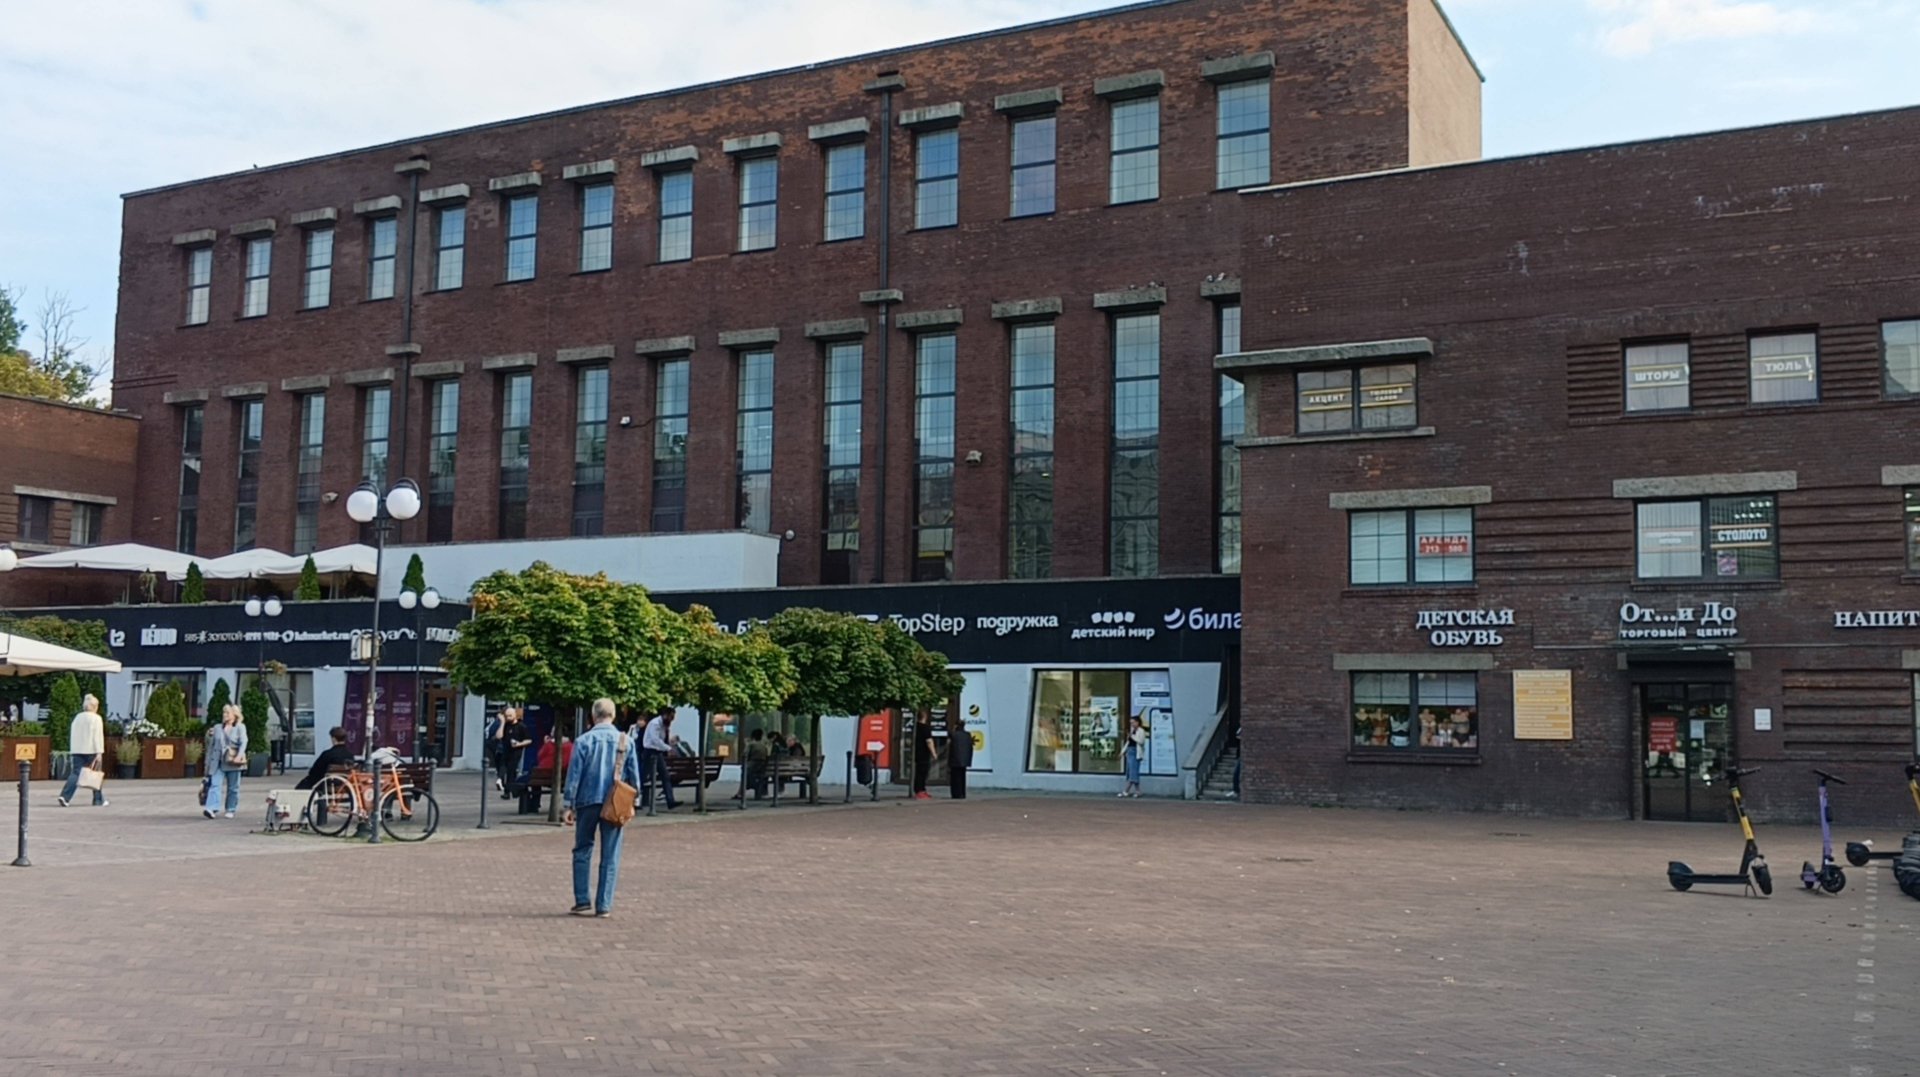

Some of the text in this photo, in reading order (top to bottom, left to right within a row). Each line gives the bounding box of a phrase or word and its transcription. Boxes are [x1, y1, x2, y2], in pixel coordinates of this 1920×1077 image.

[1765, 362, 1801, 372] ТЮЛЬ
[1634, 370, 1680, 382] ШТОРЫ
[1309, 393, 1344, 404] АКЦЕНТ
[1421, 536, 1467, 544] АРЕНДА
[1717, 528, 1767, 542] СТОЛОТО
[1415, 609, 1515, 630] ДЕТСКАЯ
[1700, 602, 1737, 626] До
[977, 615, 1058, 636] подружка
[1620, 627, 1738, 638] ТОРГОВЫЙ ЦЕНТР
[1071, 626, 1155, 640] детский мир
[1430, 630, 1503, 646] ОБУВЬ
